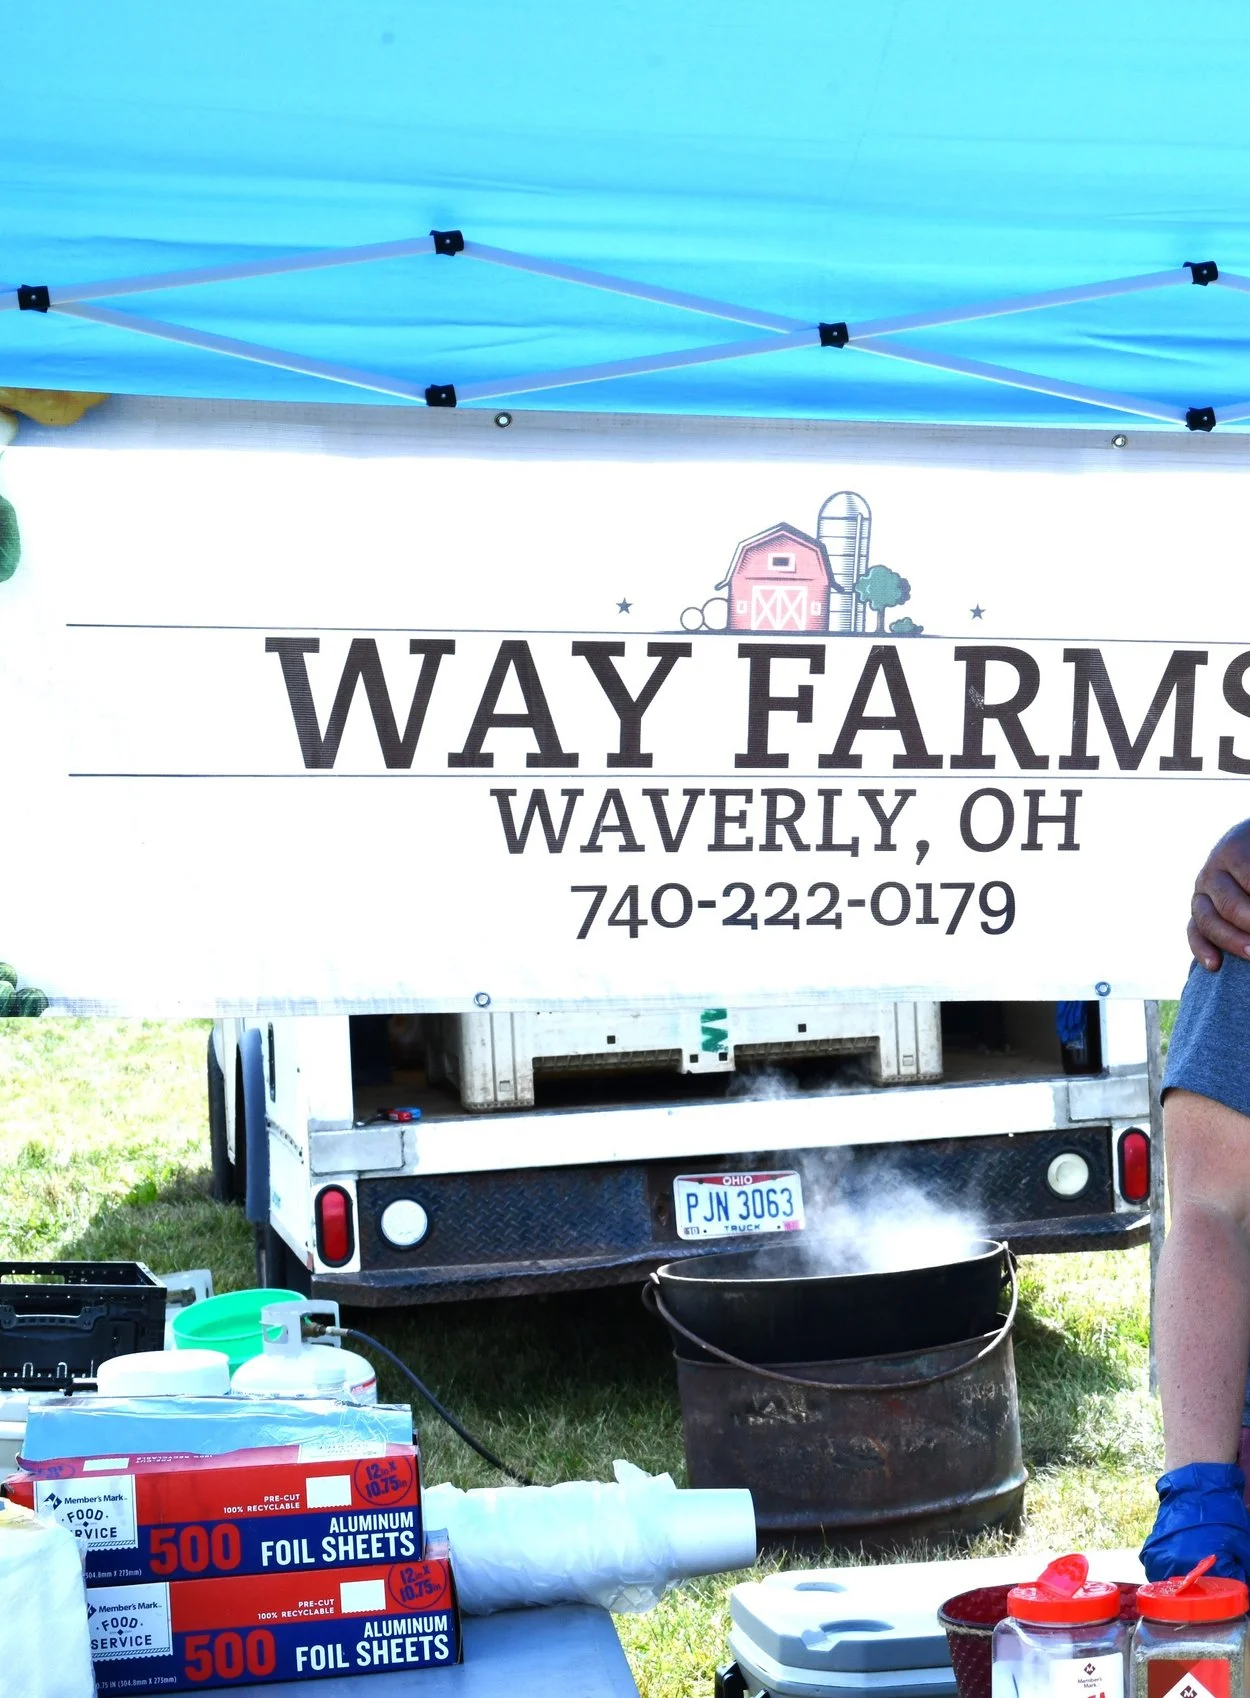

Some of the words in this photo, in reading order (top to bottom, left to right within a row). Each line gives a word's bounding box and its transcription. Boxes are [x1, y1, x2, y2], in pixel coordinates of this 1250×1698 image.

[265, 637, 692, 769] WAY
[490, 787, 930, 865] WAVERLY,
[959, 787, 1082, 852] OH
[570, 880, 1016, 939] 740-222-0179
[722, 1175, 753, 1186] OHIO
[686, 1191, 730, 1223] PJN
[737, 1188, 794, 1220] 3063
[724, 1224, 761, 1233] TRUCK
[64, 1495, 102, 1505] Member's
[103, 1493, 124, 1503] Mark
[263, 1493, 300, 1503] PRE-CUT
[67, 1508, 104, 1524] FOOD
[223, 1506, 243, 1514] 100%
[247, 1502, 300, 1512] RECYCLABLE
[329, 1511, 414, 1534] ALUMINUM
[71, 1527, 118, 1540] RVICE
[150, 1523, 241, 1575] 500
[261, 1538, 315, 1567] FOIL
[322, 1530, 415, 1563] SHEETS
[98, 1603, 136, 1613] Member's
[138, 1601, 158, 1610] Mark
[298, 1599, 334, 1608] PRE-CUT
[257, 1612, 278, 1620] 100%
[281, 1607, 334, 1618] RECYCLABLE
[101, 1616, 138, 1632] FOOD
[364, 1615, 448, 1638] ALUMINUM
[90, 1634, 152, 1650] SERVICE
[184, 1629, 276, 1682] 500
[296, 1643, 350, 1672] FOIL
[356, 1634, 449, 1667] SHEETS
